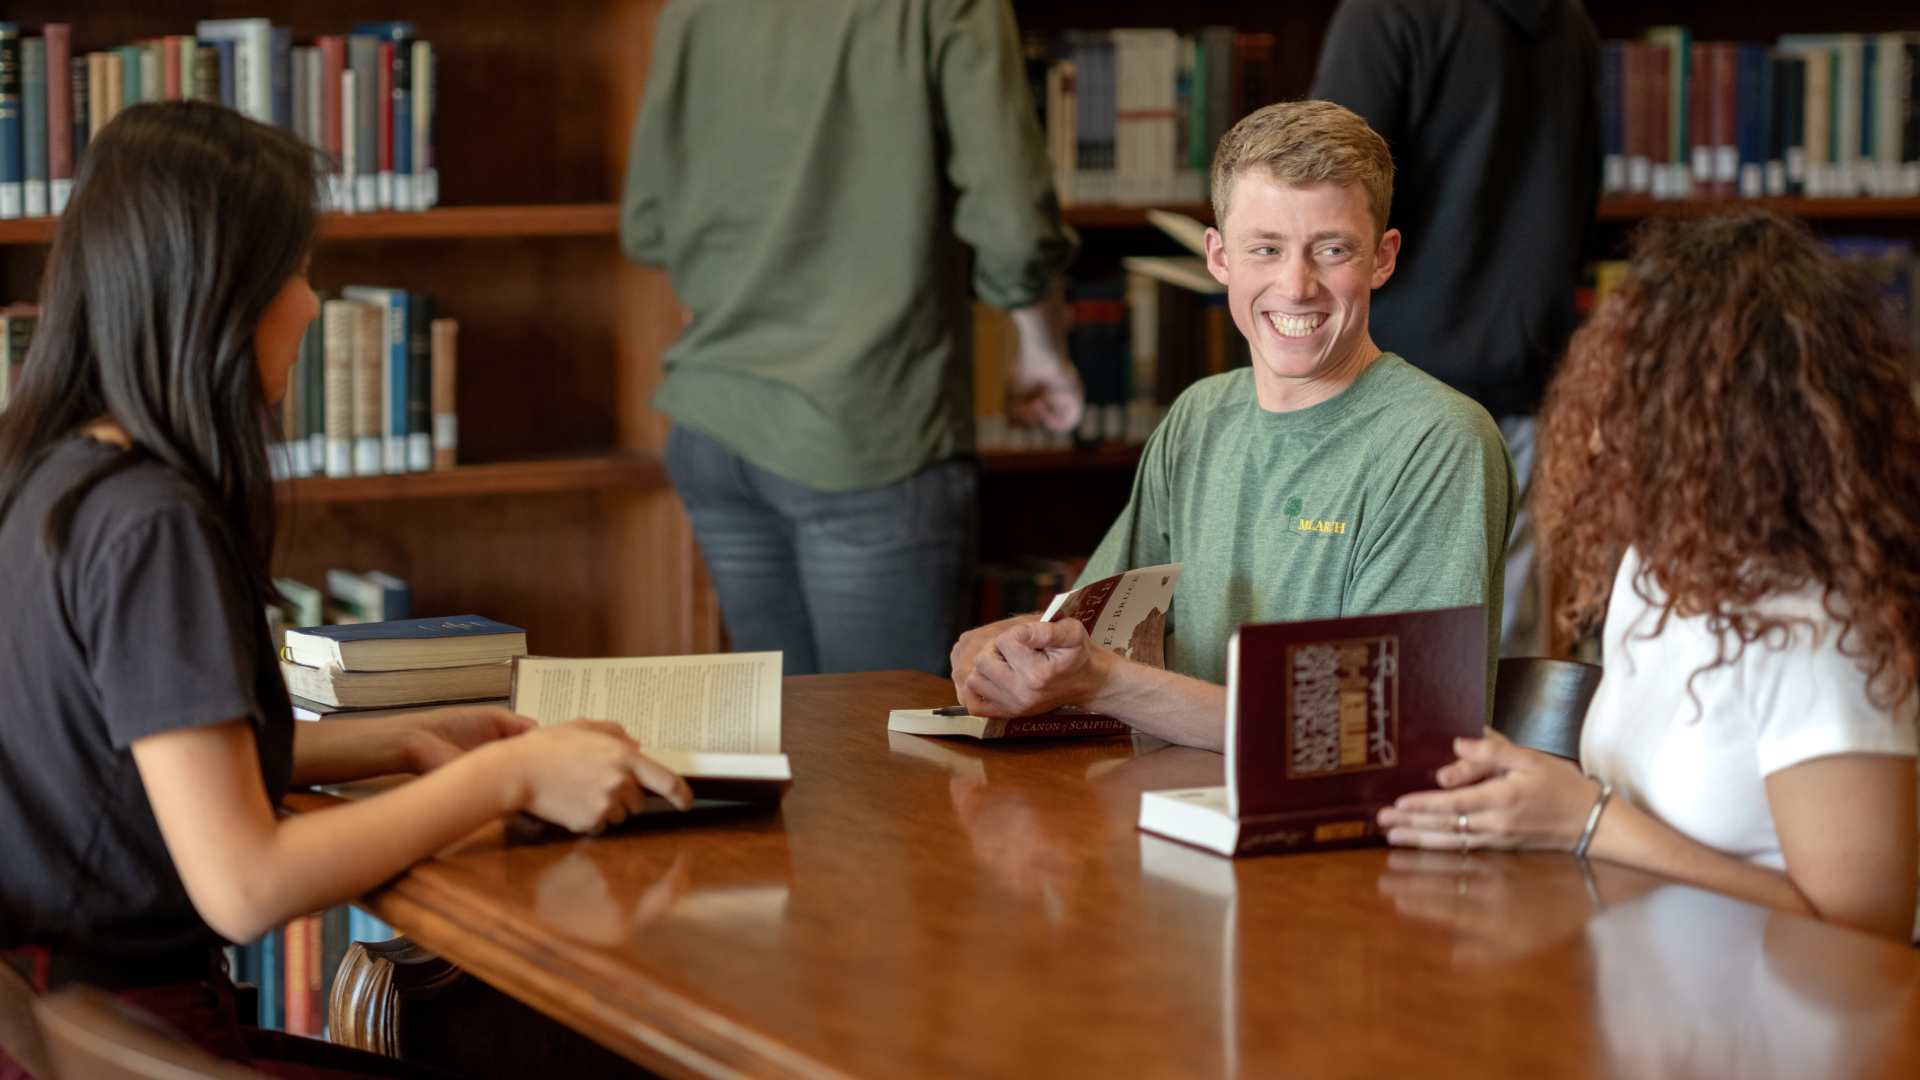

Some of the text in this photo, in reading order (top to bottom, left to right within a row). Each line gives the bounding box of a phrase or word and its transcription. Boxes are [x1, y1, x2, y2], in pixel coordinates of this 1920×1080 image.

[1112, 575, 1140, 618] BRUCE
[1022, 722, 1060, 732] CANON
[1069, 720, 1125, 730] SCRIPTURE
